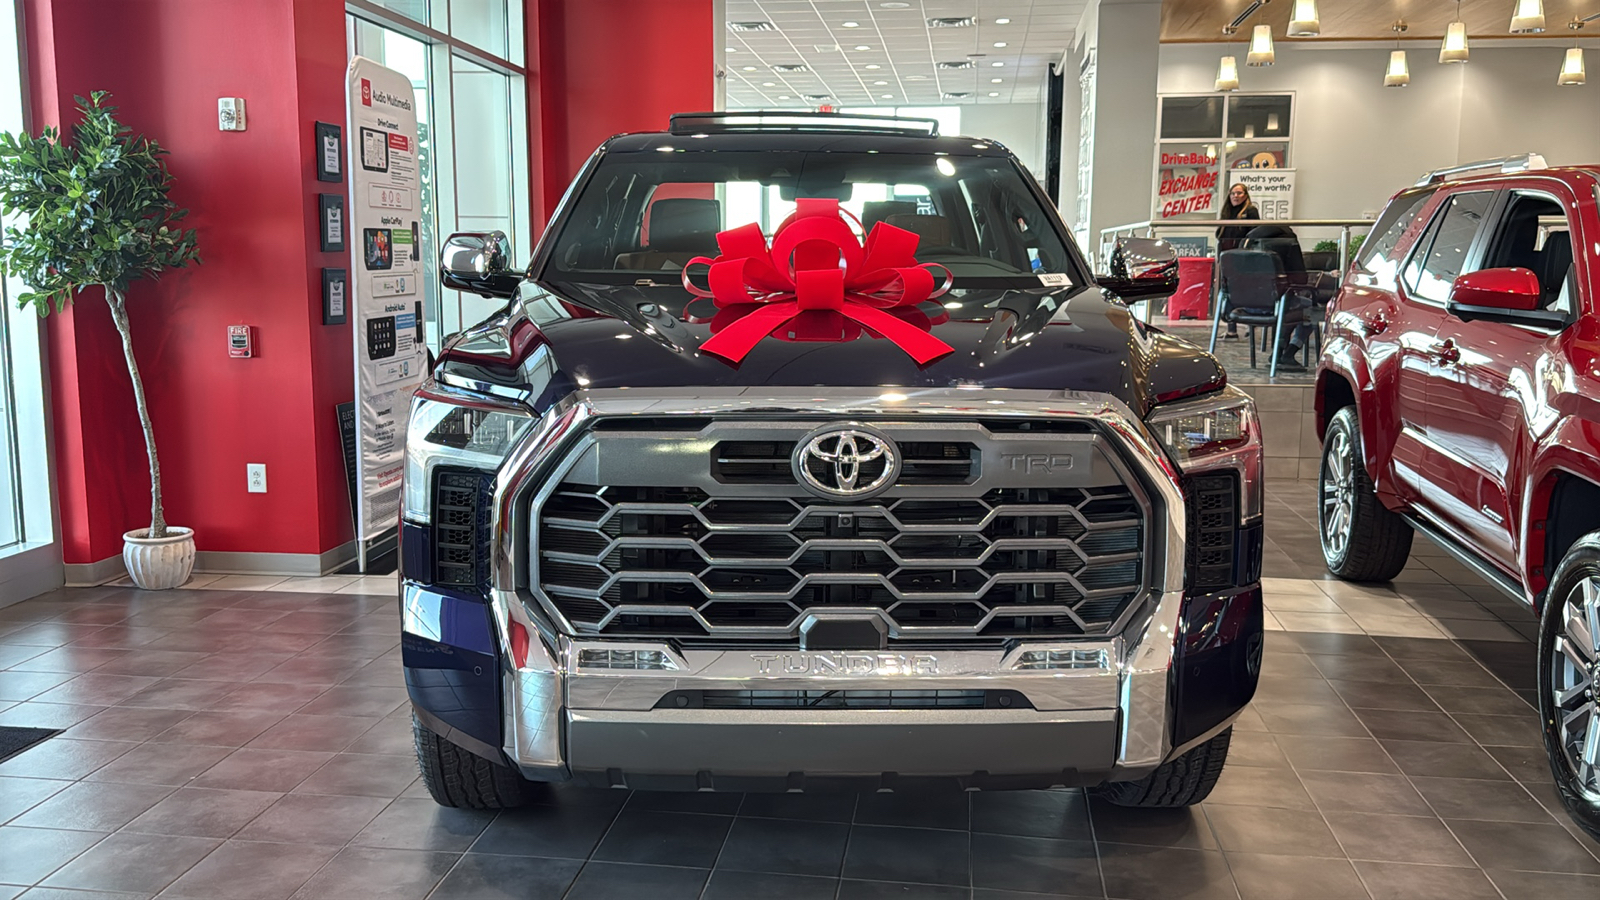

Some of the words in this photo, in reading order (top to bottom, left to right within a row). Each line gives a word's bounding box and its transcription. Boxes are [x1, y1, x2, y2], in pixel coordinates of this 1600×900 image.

[373, 90, 386, 104] Audio
[387, 94, 411, 111] Multimedia
[1161, 152, 1217, 166] DriveBaby
[1159, 171, 1219, 196] EXCHANGE
[1268, 176, 1286, 184] your
[1264, 184, 1291, 192] worth?
[1162, 193, 1212, 218] CENTER
[381, 216, 390, 226] Apple
[385, 304, 397, 312] Android
[230, 327, 247, 335] FIRE
[1000, 454, 1073, 474] TRD
[750, 655, 940, 675] TUNDRA
